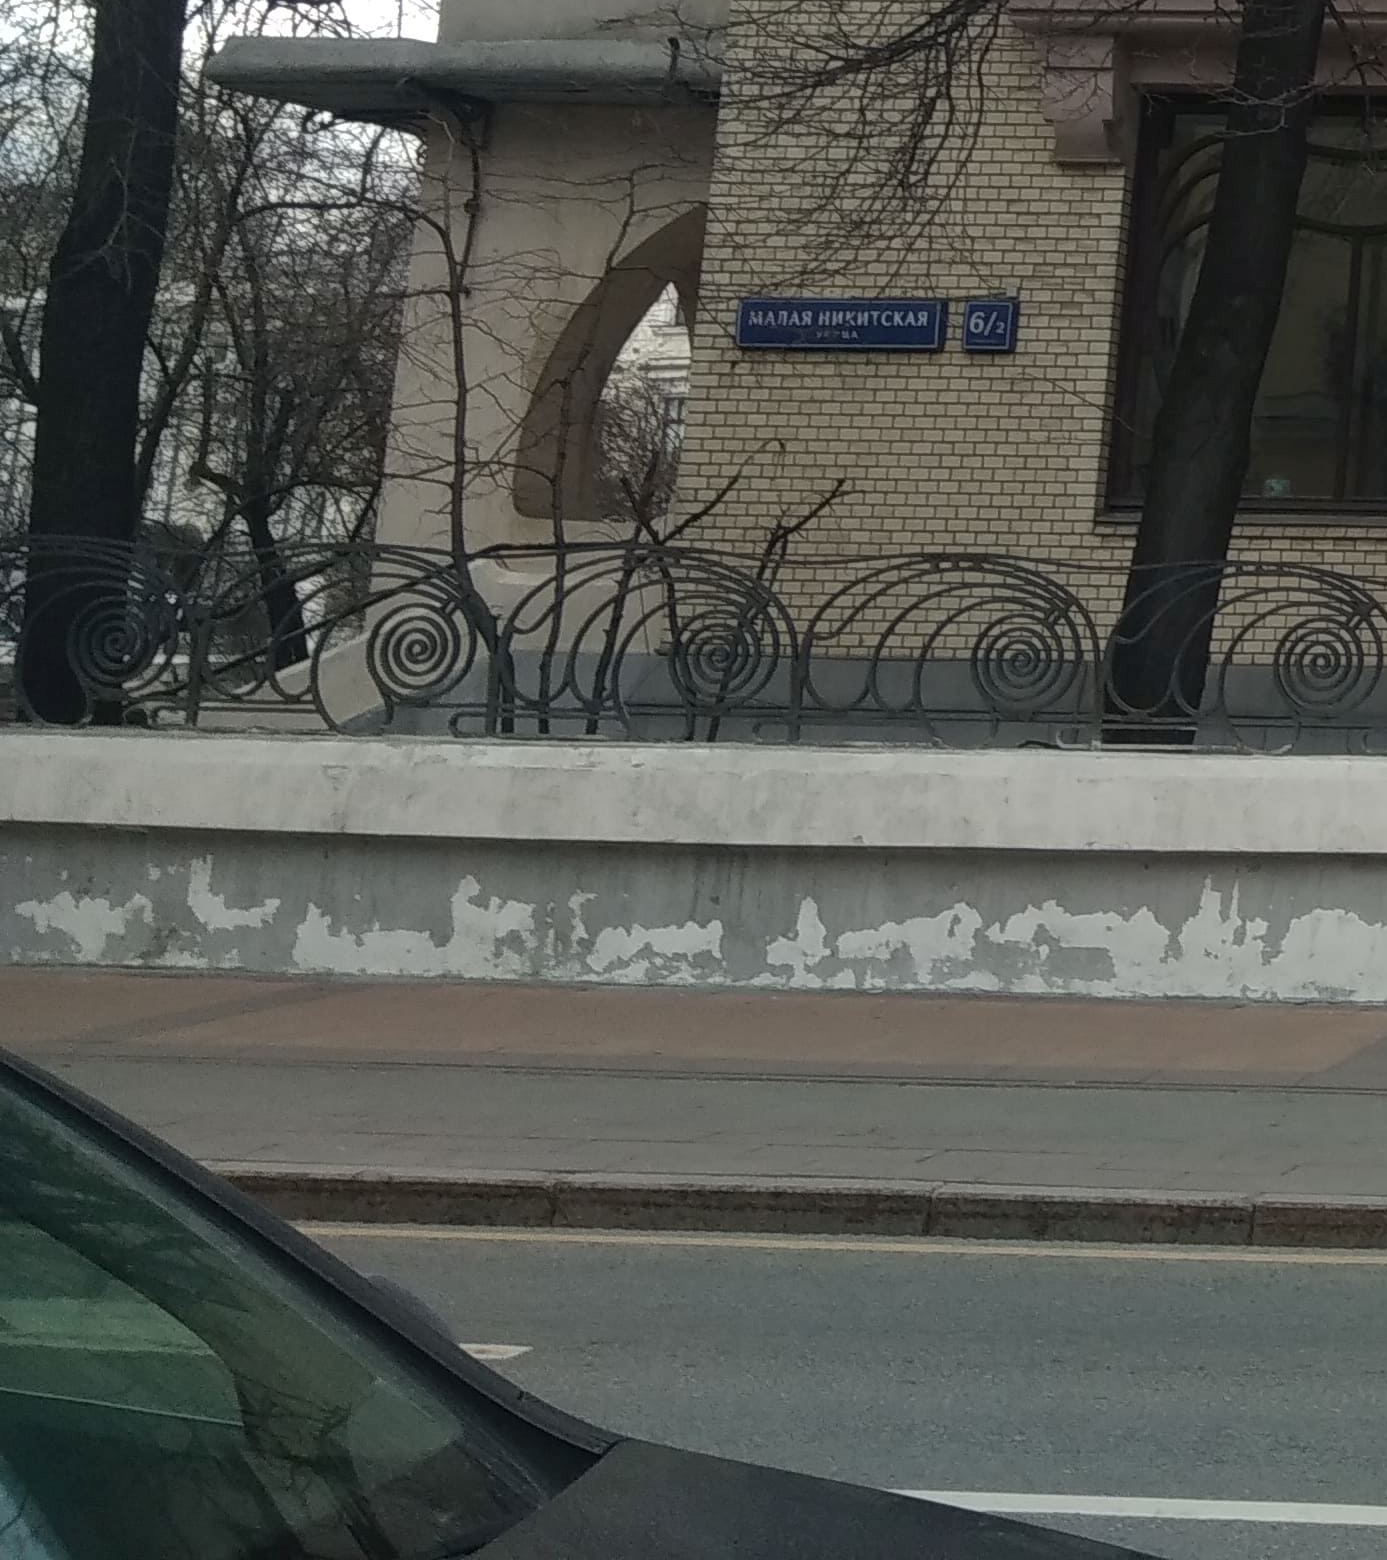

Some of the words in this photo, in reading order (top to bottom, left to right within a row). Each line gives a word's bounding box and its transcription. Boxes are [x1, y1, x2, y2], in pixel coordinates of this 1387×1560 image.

[748, 309, 812, 327] МАЛАЯ
[818, 309, 929, 327] НИКИТСКАЯ
[816, 330, 859, 340] УЦА
